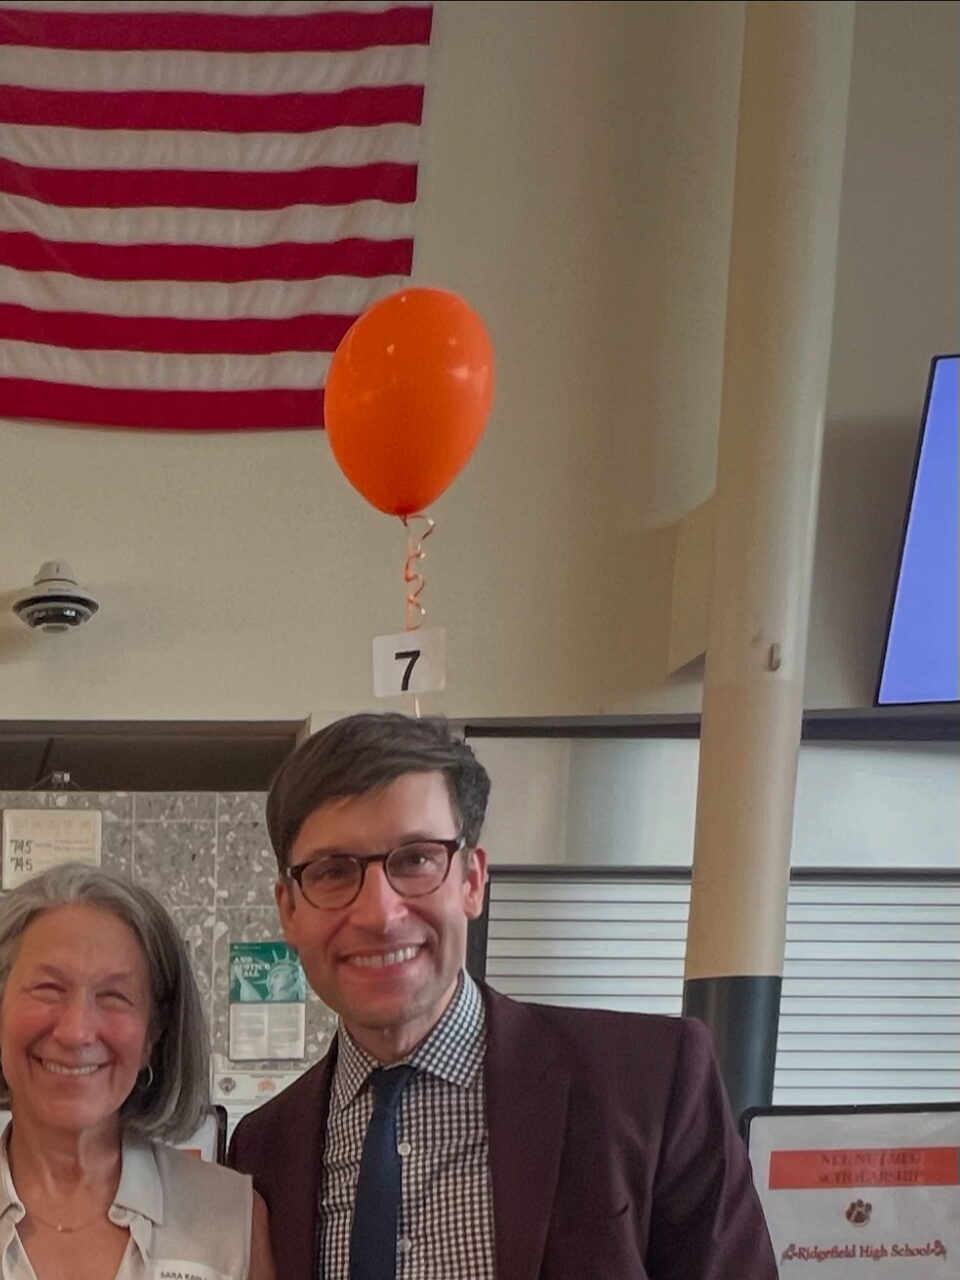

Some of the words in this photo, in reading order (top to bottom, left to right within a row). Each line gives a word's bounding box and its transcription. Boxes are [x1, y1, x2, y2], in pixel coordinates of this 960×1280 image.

[394, 649, 421, 692] 7
[798, 1244, 856, 1263] Ridgefield
[859, 1245, 888, 1261] High
[890, 1242, 932, 1257] School
[160, 1271, 183, 1280] SARA
